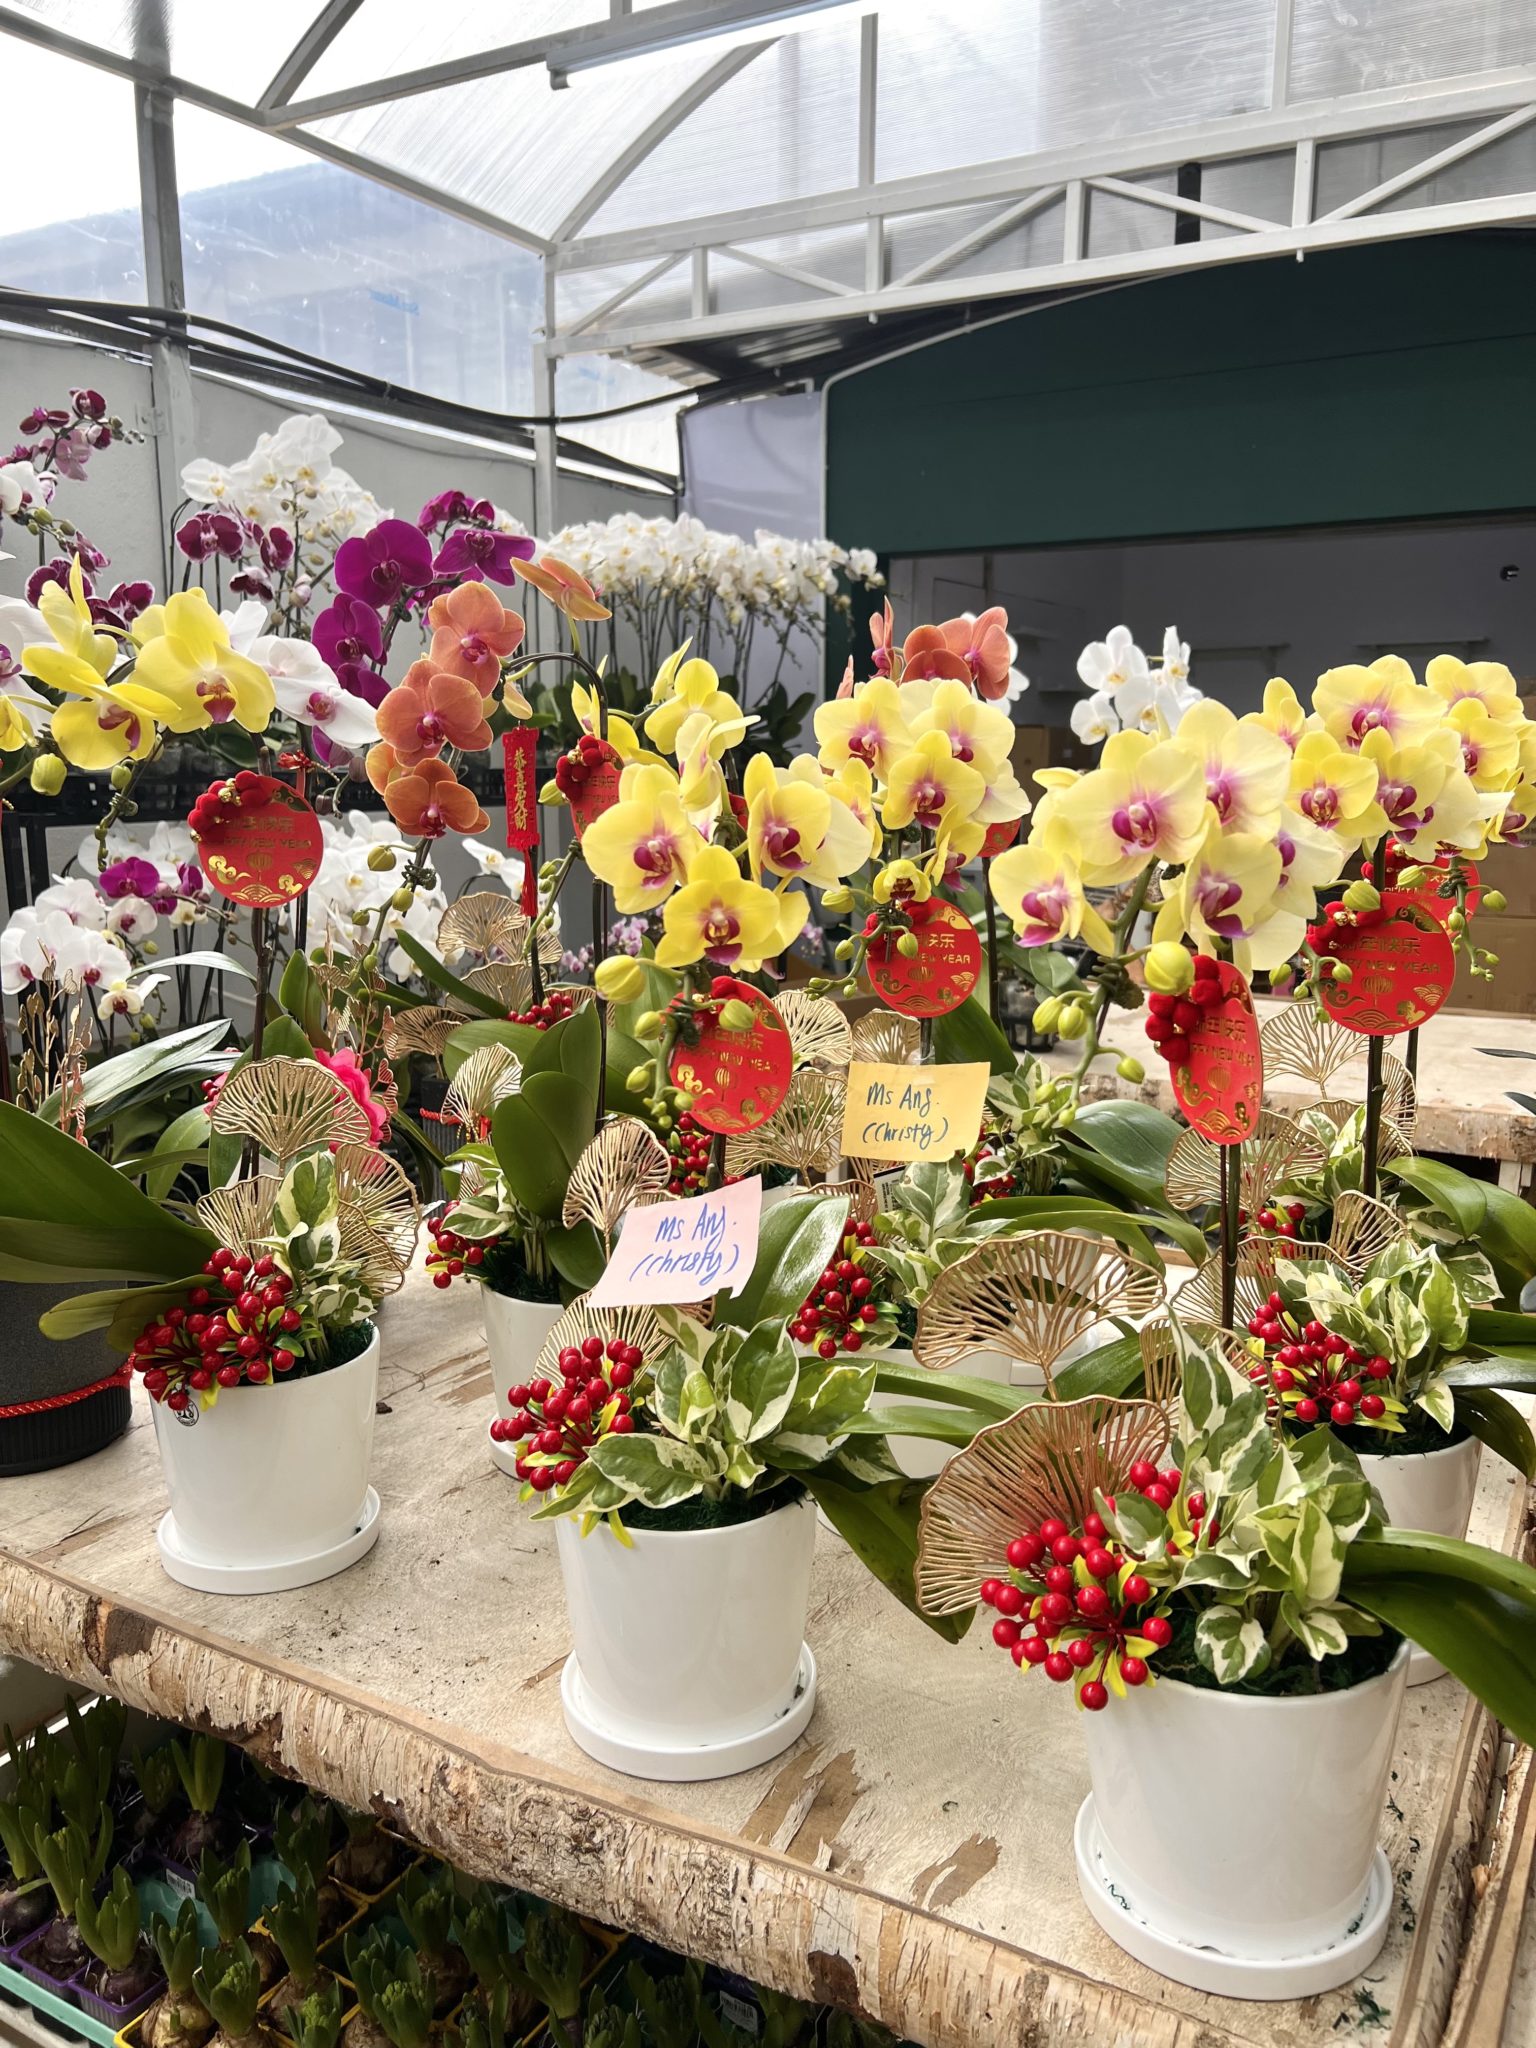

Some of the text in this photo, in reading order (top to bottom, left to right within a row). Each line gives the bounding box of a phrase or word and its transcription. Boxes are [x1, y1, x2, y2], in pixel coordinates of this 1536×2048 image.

[941, 953, 972, 965] YEAR
[1366, 959, 1397, 972] NEW
[1403, 960, 1440, 975] YEAR
[866, 1081, 894, 1106] Ms
[862, 1116, 949, 1150] (Christy)
[654, 1215, 685, 1242] Ms
